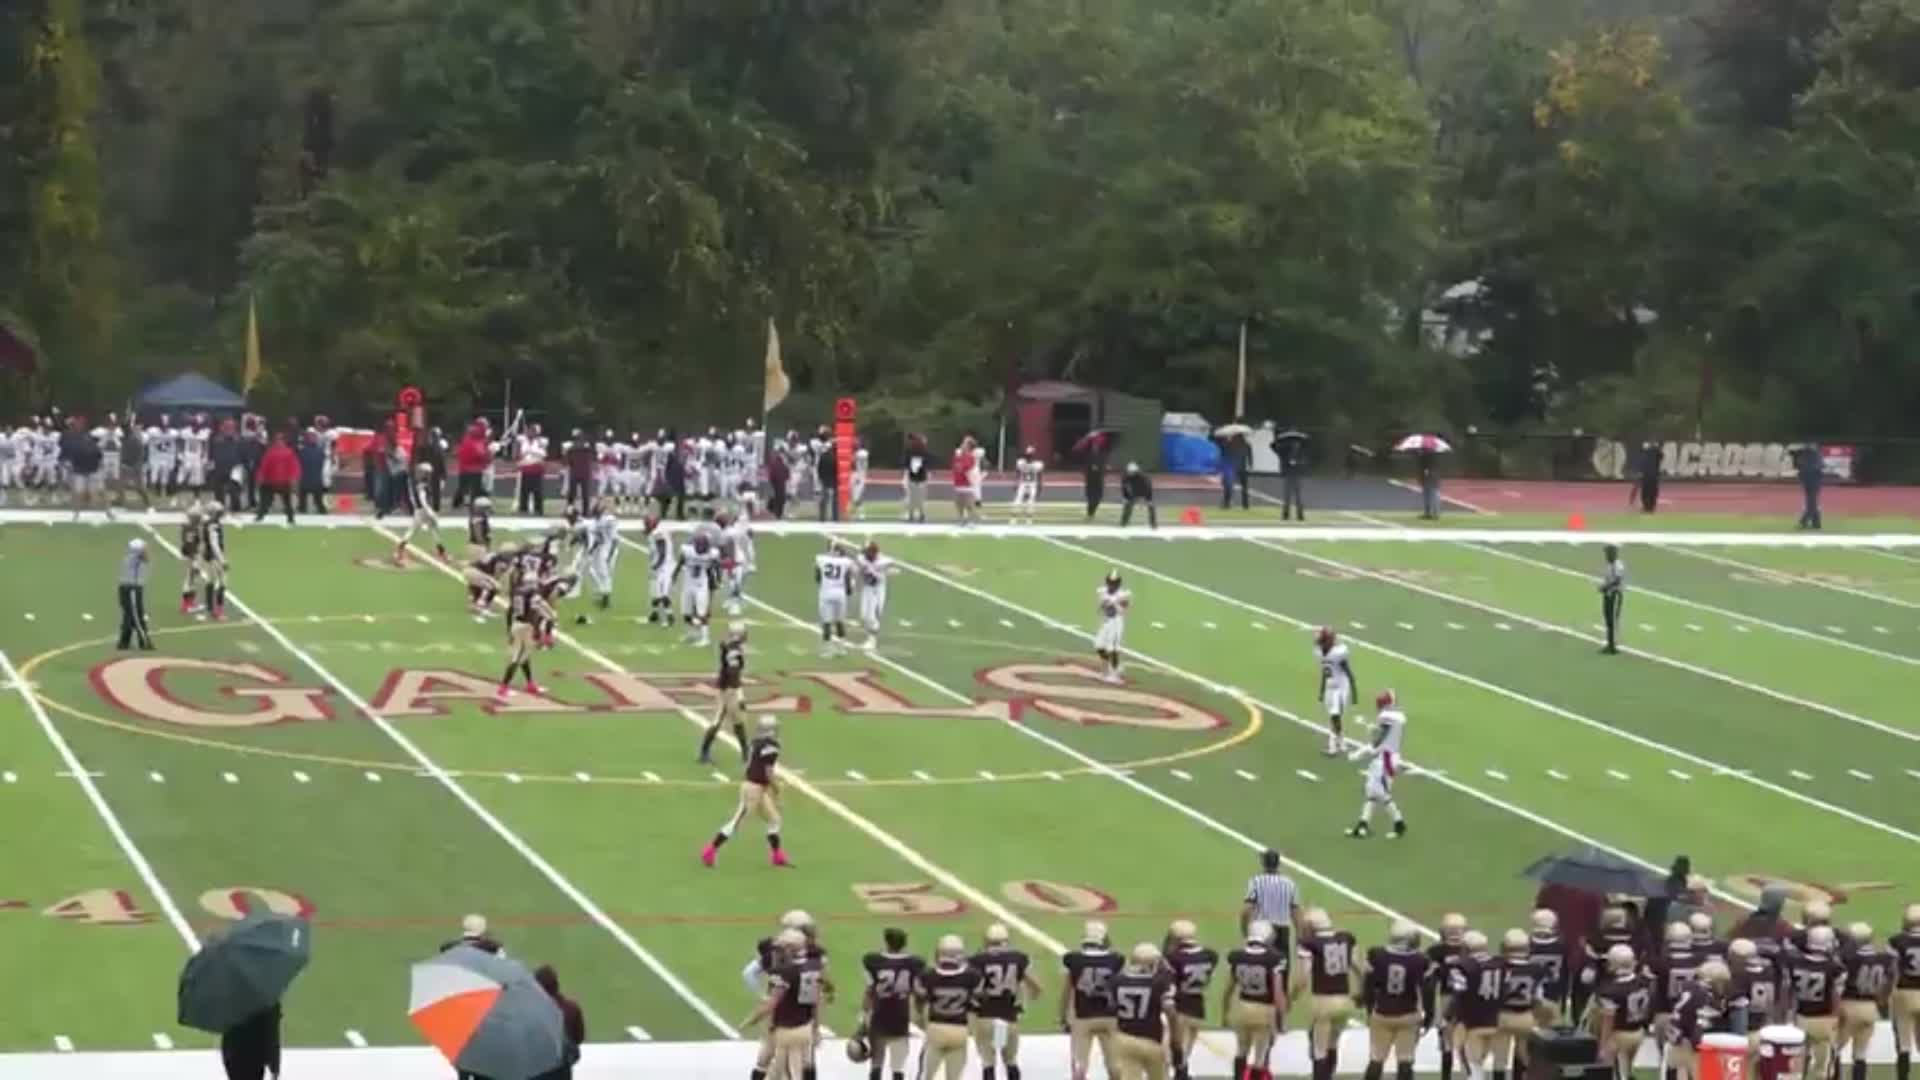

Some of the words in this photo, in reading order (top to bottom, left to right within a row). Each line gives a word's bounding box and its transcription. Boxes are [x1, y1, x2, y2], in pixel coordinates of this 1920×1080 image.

[87, 654, 1231, 730] GAELS
[850, 879, 1117, 915] 50
[875, 967, 912, 999] 24
[984, 963, 1018, 996] 34
[1386, 963, 1407, 995] 8
[932, 987, 970, 1015] 22
[1116, 985, 1151, 1019] 57
